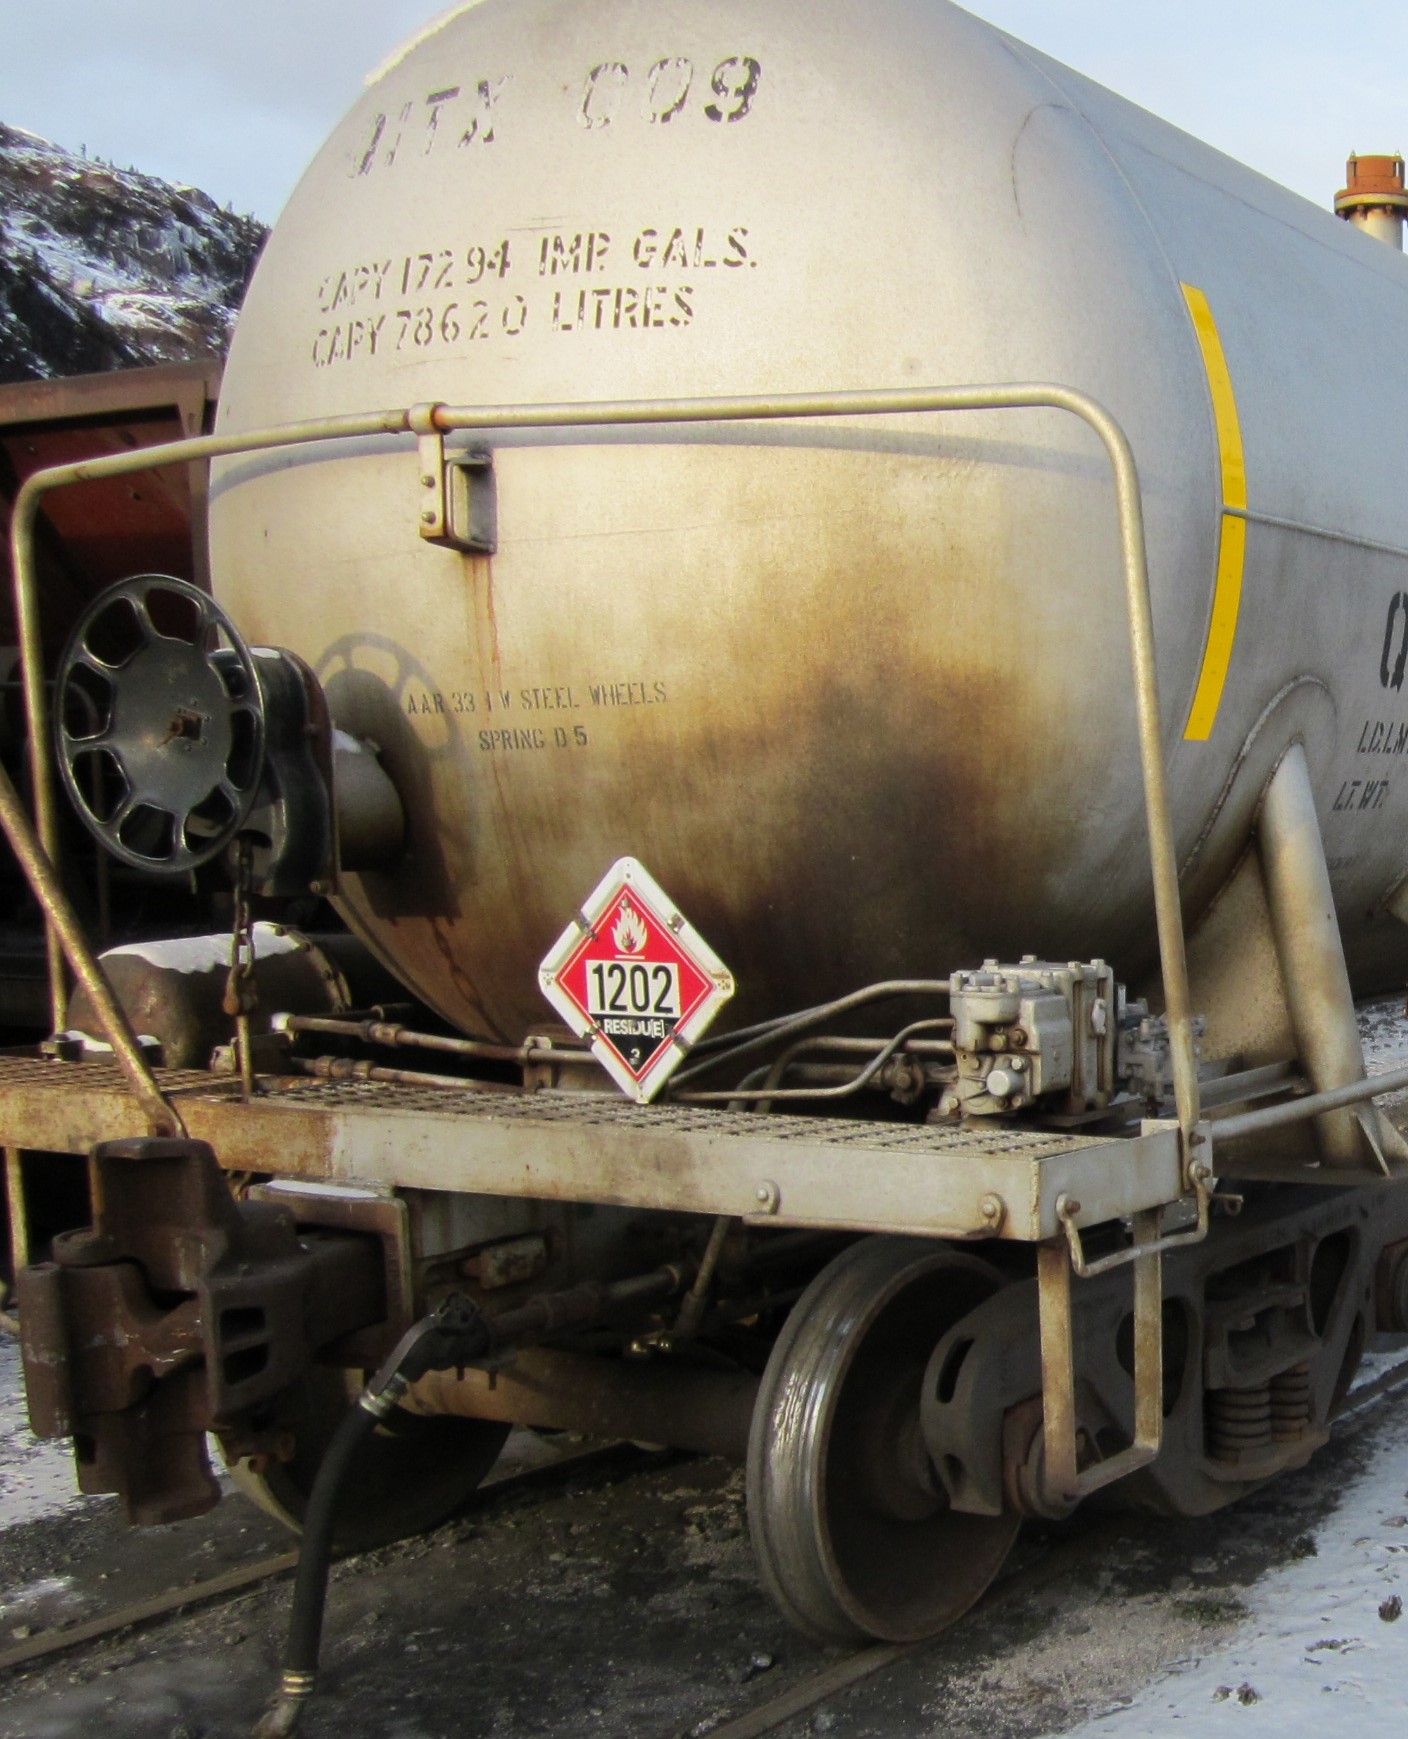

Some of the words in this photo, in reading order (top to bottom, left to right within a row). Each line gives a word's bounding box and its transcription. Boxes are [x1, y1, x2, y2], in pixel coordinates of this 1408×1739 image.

[551, 286, 695, 333] LITRES
[519, 686, 580, 710] STEEL
[589, 681, 669, 706] WHEELS
[478, 728, 545, 751] SPRING
[573, 725, 588, 747] 5
[592, 963, 674, 1014] 1202
